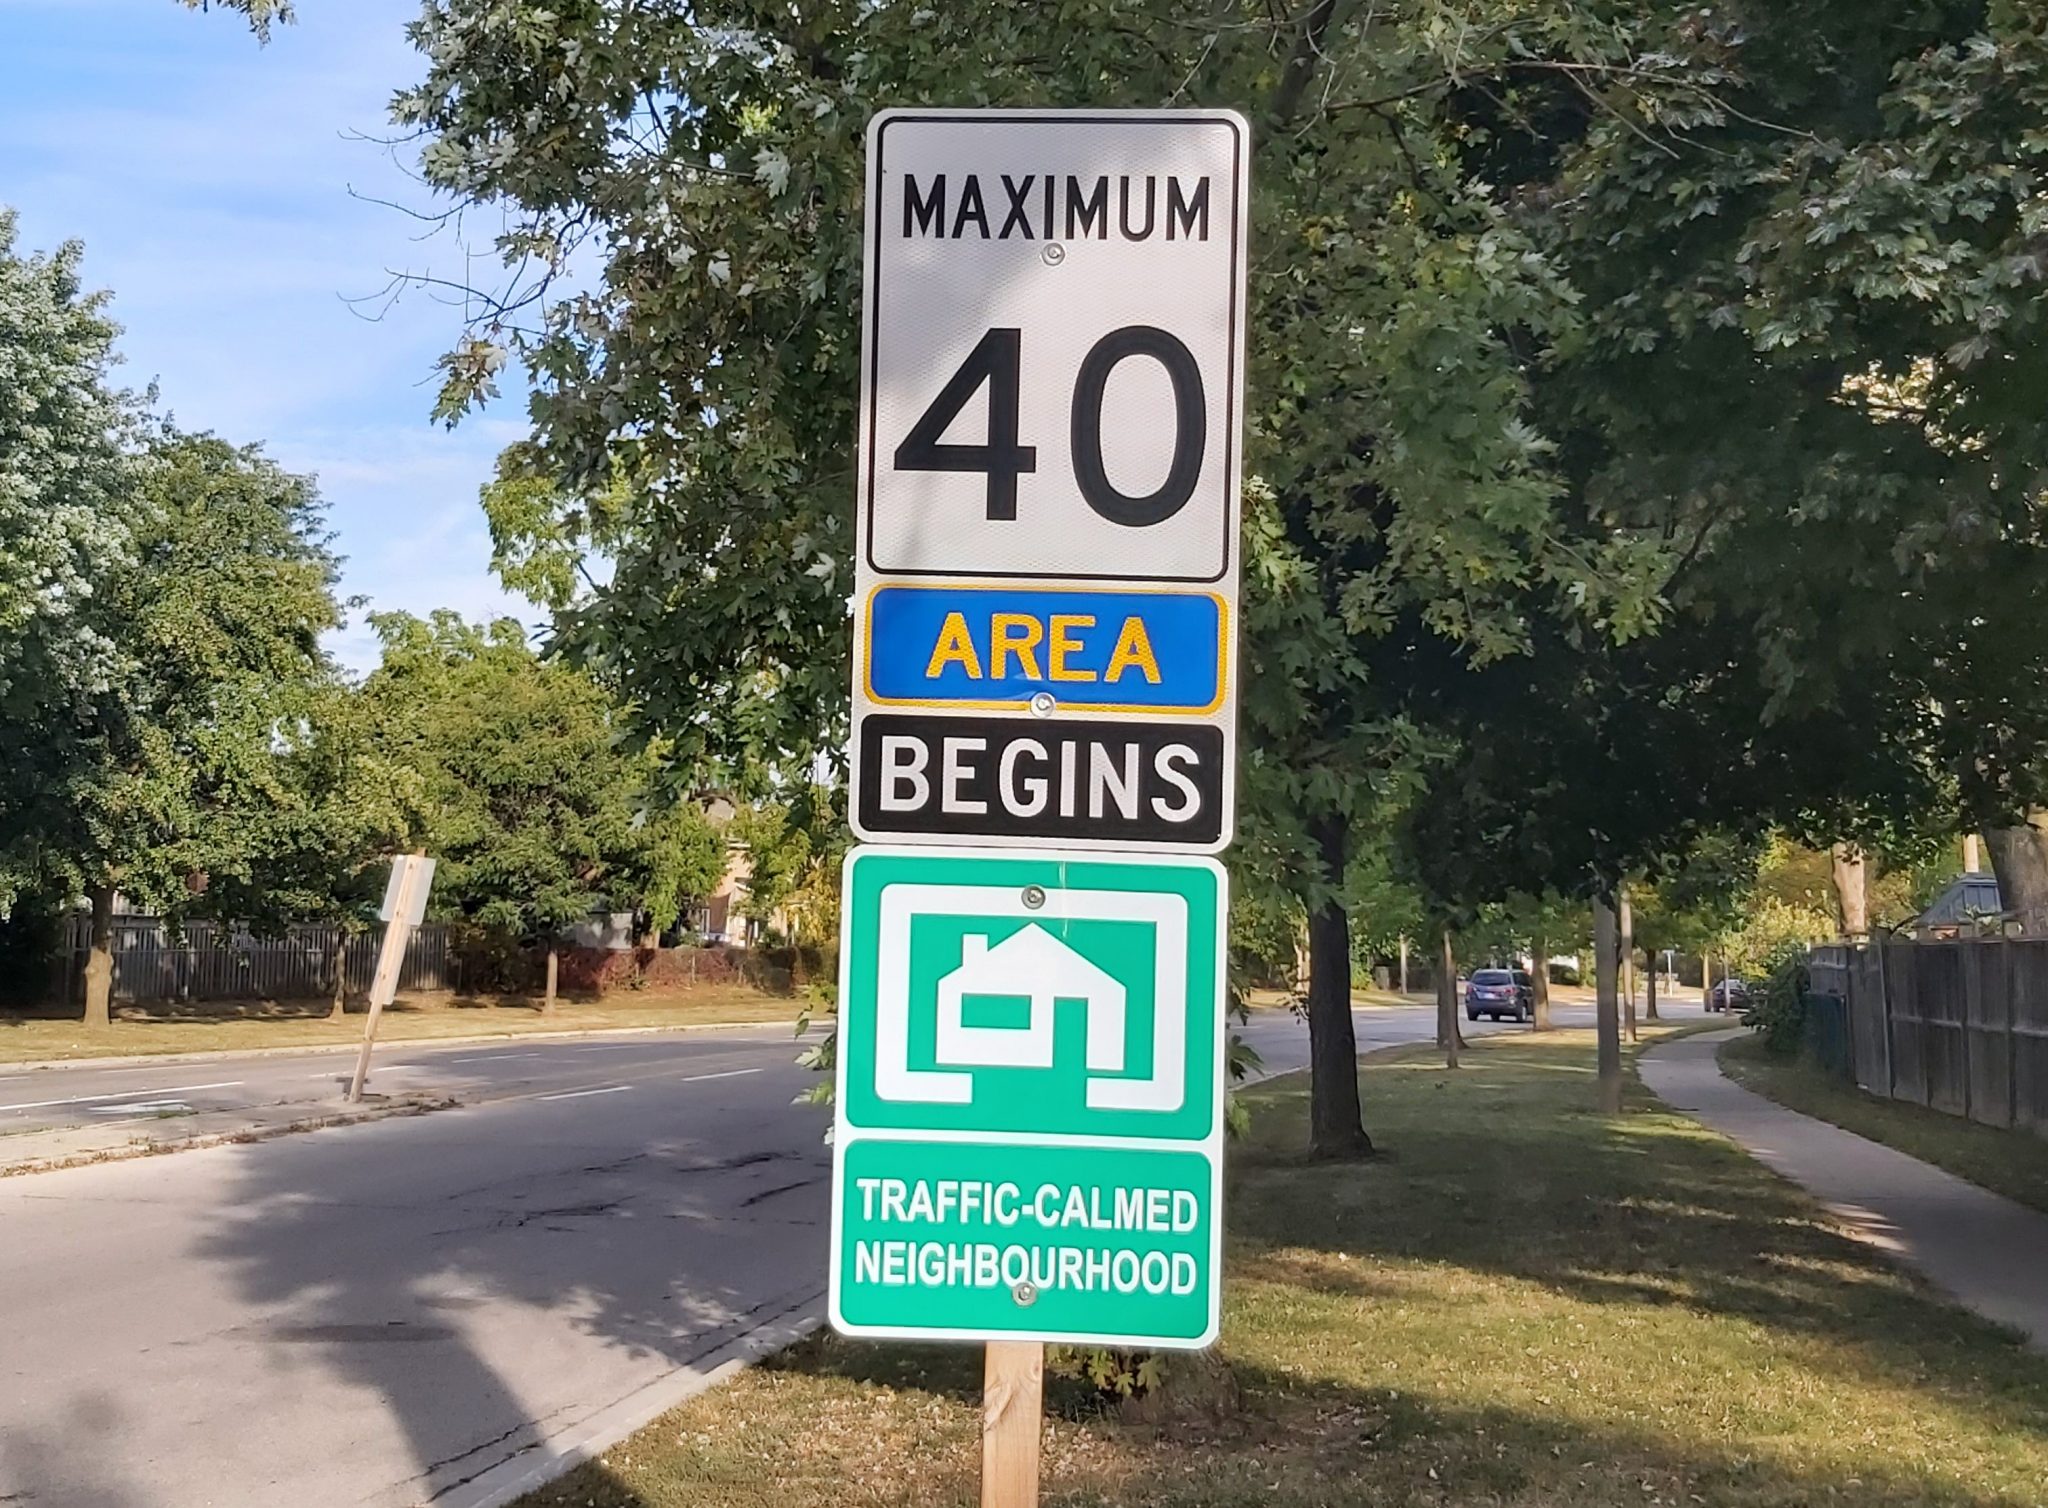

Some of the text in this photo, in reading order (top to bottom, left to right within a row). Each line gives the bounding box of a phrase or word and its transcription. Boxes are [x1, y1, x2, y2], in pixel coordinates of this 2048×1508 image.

[903, 174, 1210, 241] MAXIMUM
[894, 325, 1206, 527] 40
[925, 612, 1162, 684] AREA
[879, 735, 1201, 823] BEGINS
[855, 1178, 1198, 1232] TRAFFIC-CALMED
[854, 1240, 1197, 1295] NEIGHBOURHOOD
